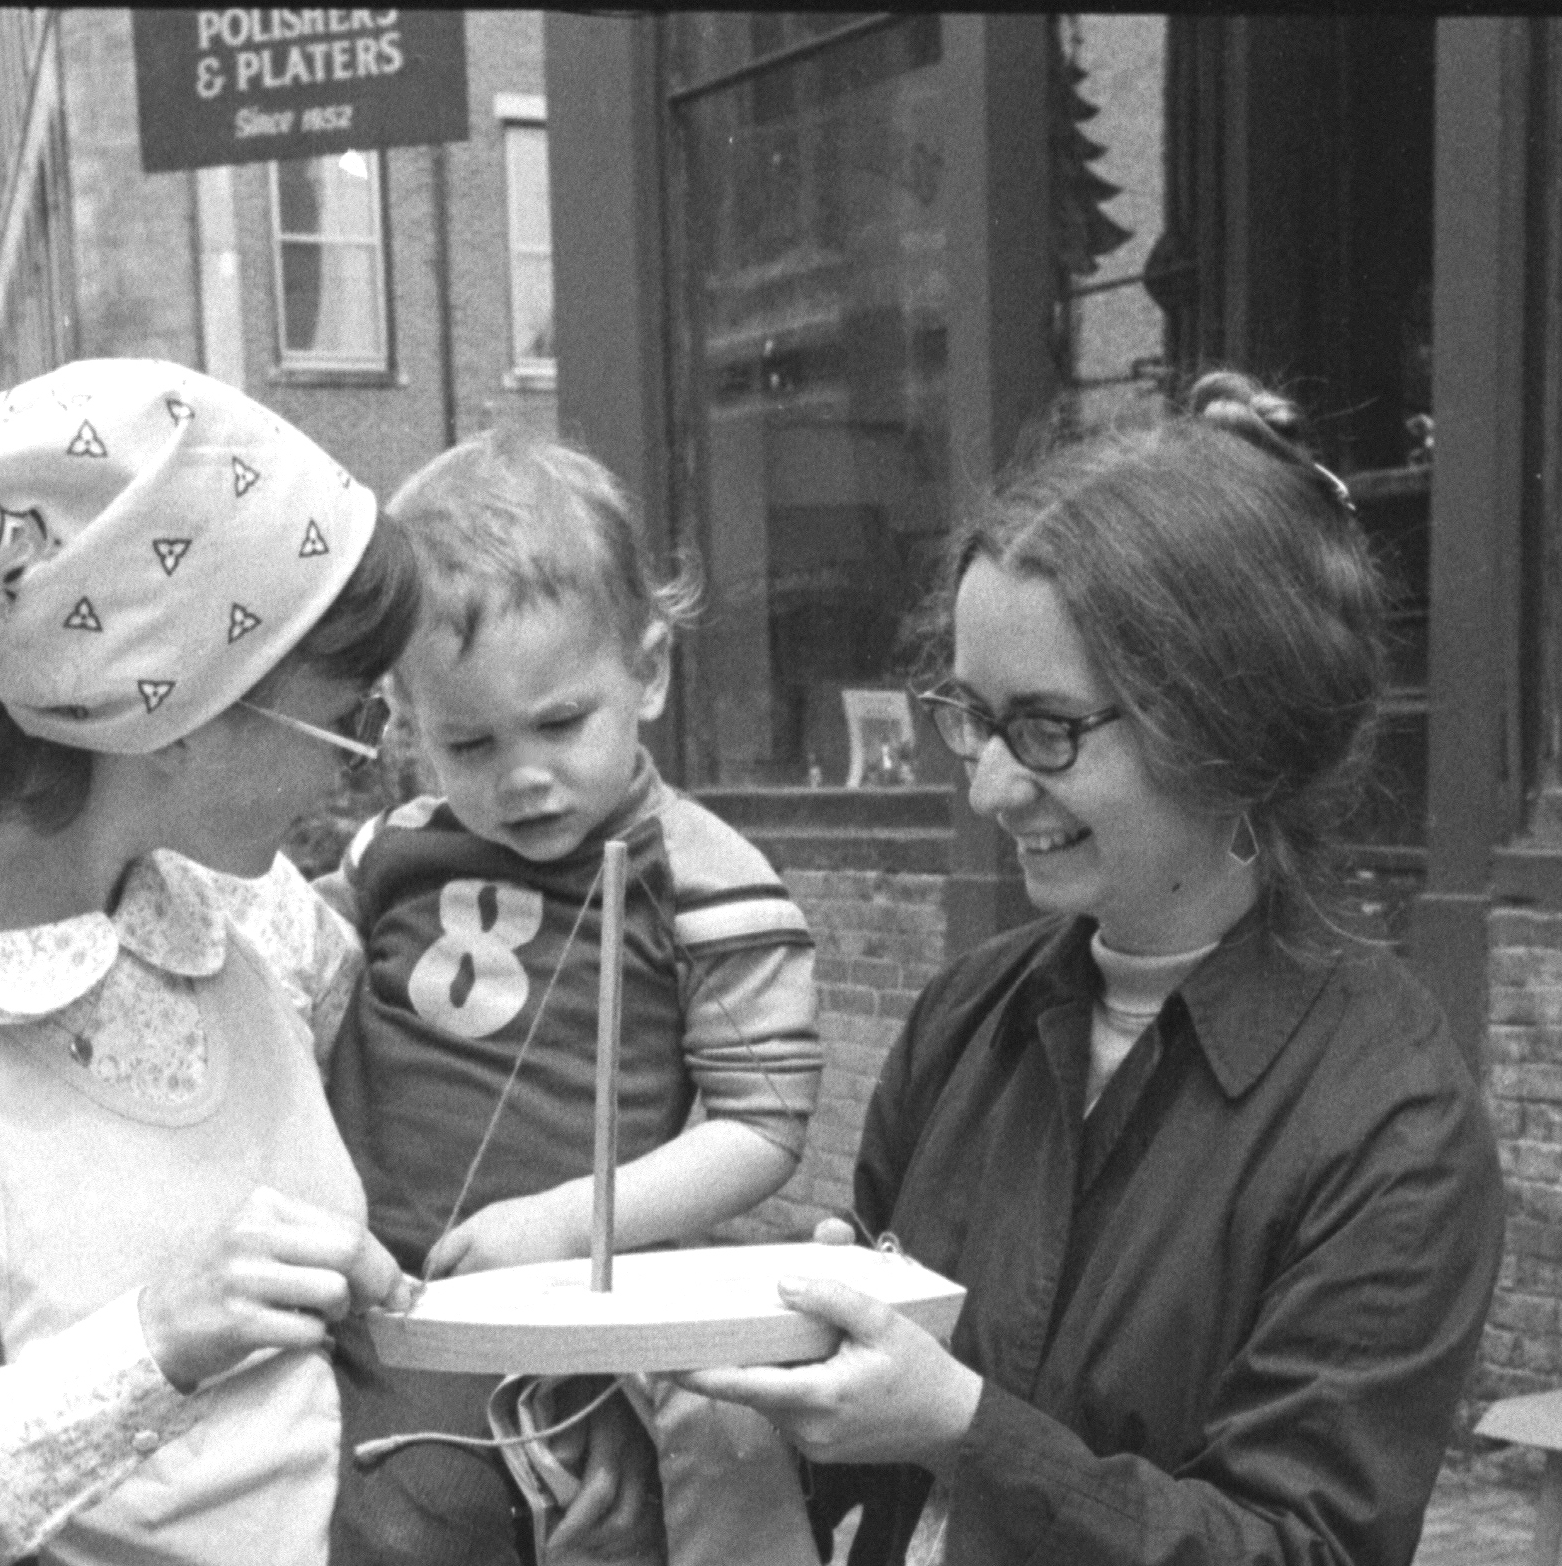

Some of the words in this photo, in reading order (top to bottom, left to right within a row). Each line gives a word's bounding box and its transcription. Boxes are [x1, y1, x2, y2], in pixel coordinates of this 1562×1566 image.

[196, 56, 226, 99] &
[236, 31, 404, 92] PLATERS
[407, 879, 543, 1038] 8
